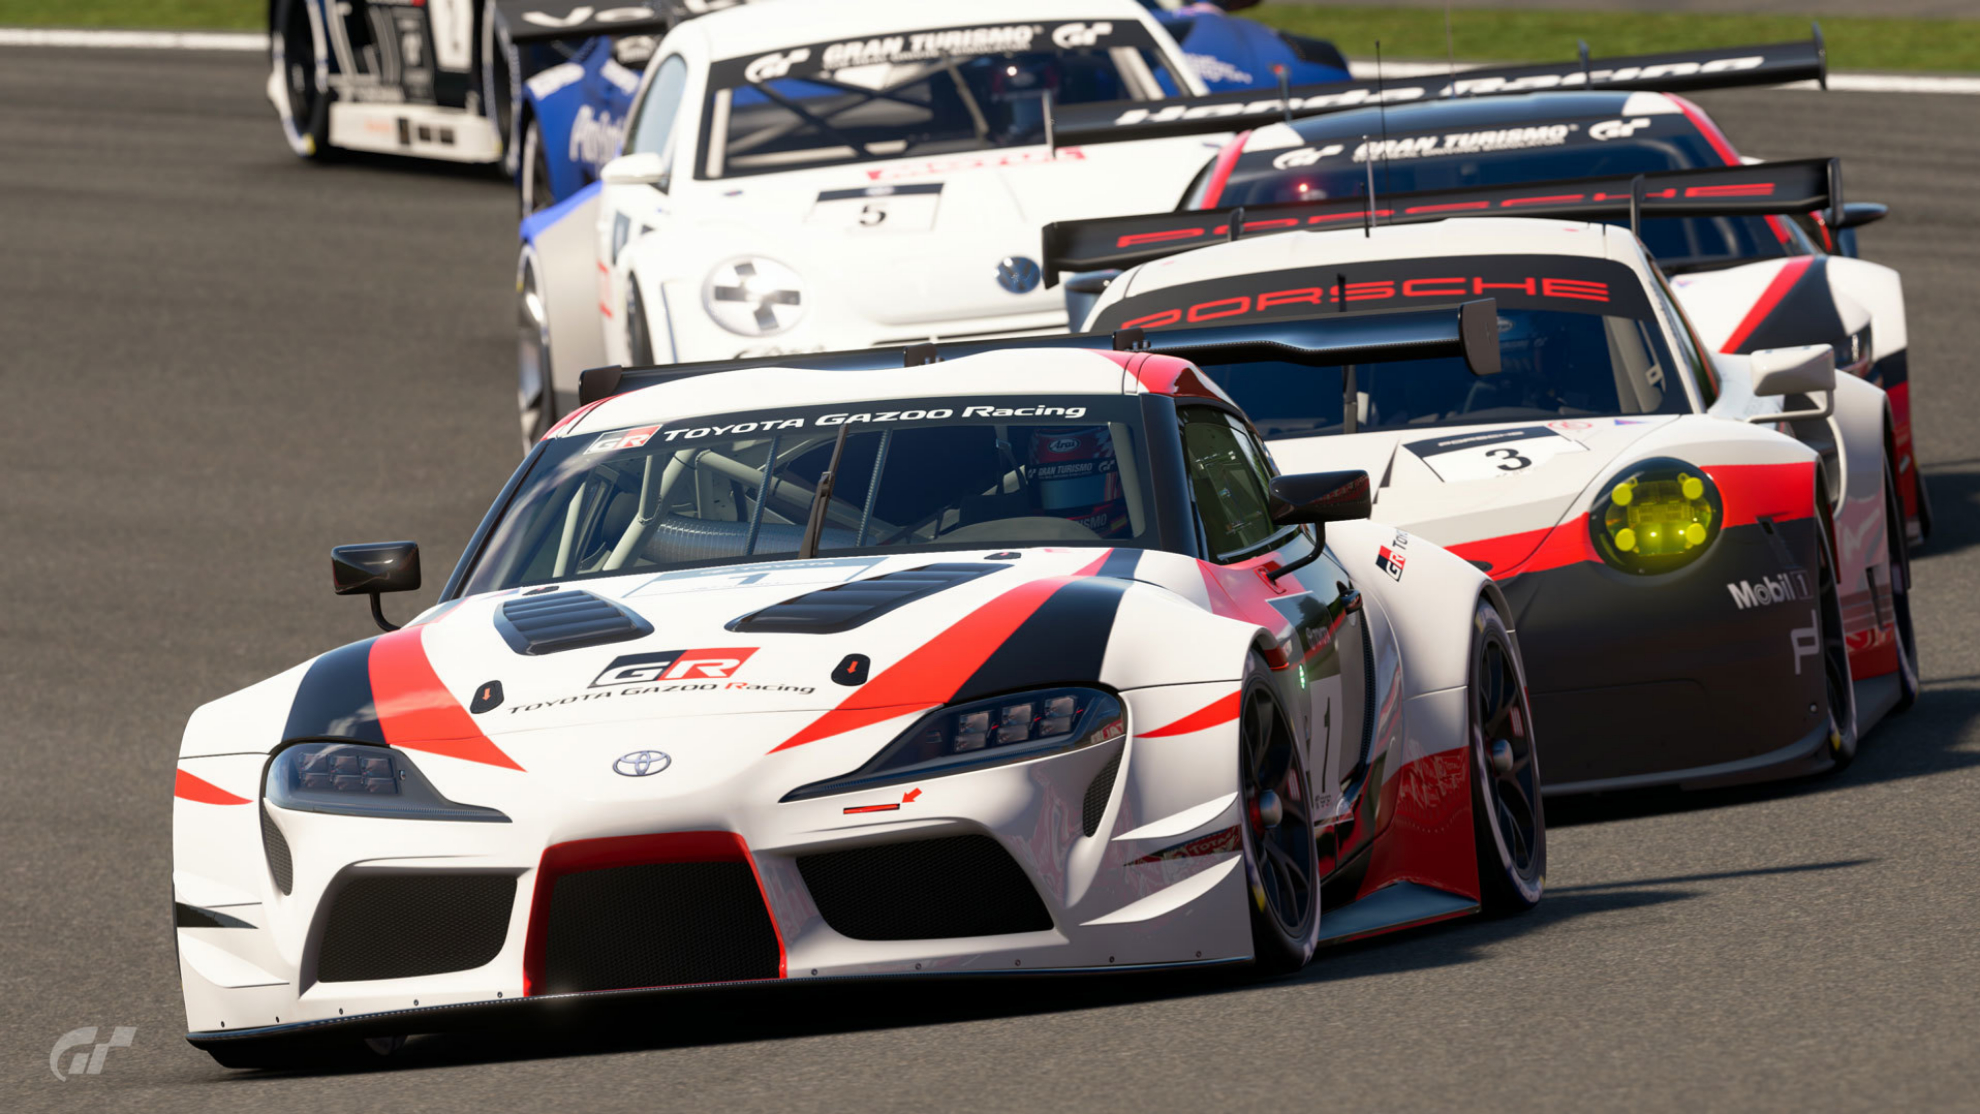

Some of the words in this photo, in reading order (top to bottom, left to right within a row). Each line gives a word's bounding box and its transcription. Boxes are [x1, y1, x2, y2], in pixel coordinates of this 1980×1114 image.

[822, 35, 905, 64] GRAN
[910, 24, 1034, 54] TURISMO
[1354, 135, 1439, 160] GRAN
[1444, 123, 1570, 150] TURISMO
[859, 204, 887, 227] 5
[1121, 276, 1610, 330] PORSCHE
[591, 434, 652, 450] GR
[663, 417, 805, 442] TOYOTA
[814, 408, 954, 427] GAZOO
[961, 403, 1088, 420] Racing
[1038, 466, 1056, 477] GRAN
[1057, 462, 1093, 474] TURISMO
[1485, 448, 1532, 471] 3
[1727, 573, 1796, 610] Mobil
[594, 658, 743, 687] GR
[508, 690, 614, 715] TOYOTA
[620, 683, 718, 697] GAZOO
[724, 681, 816, 695] Racing
[1323, 695, 1332, 794] 1
